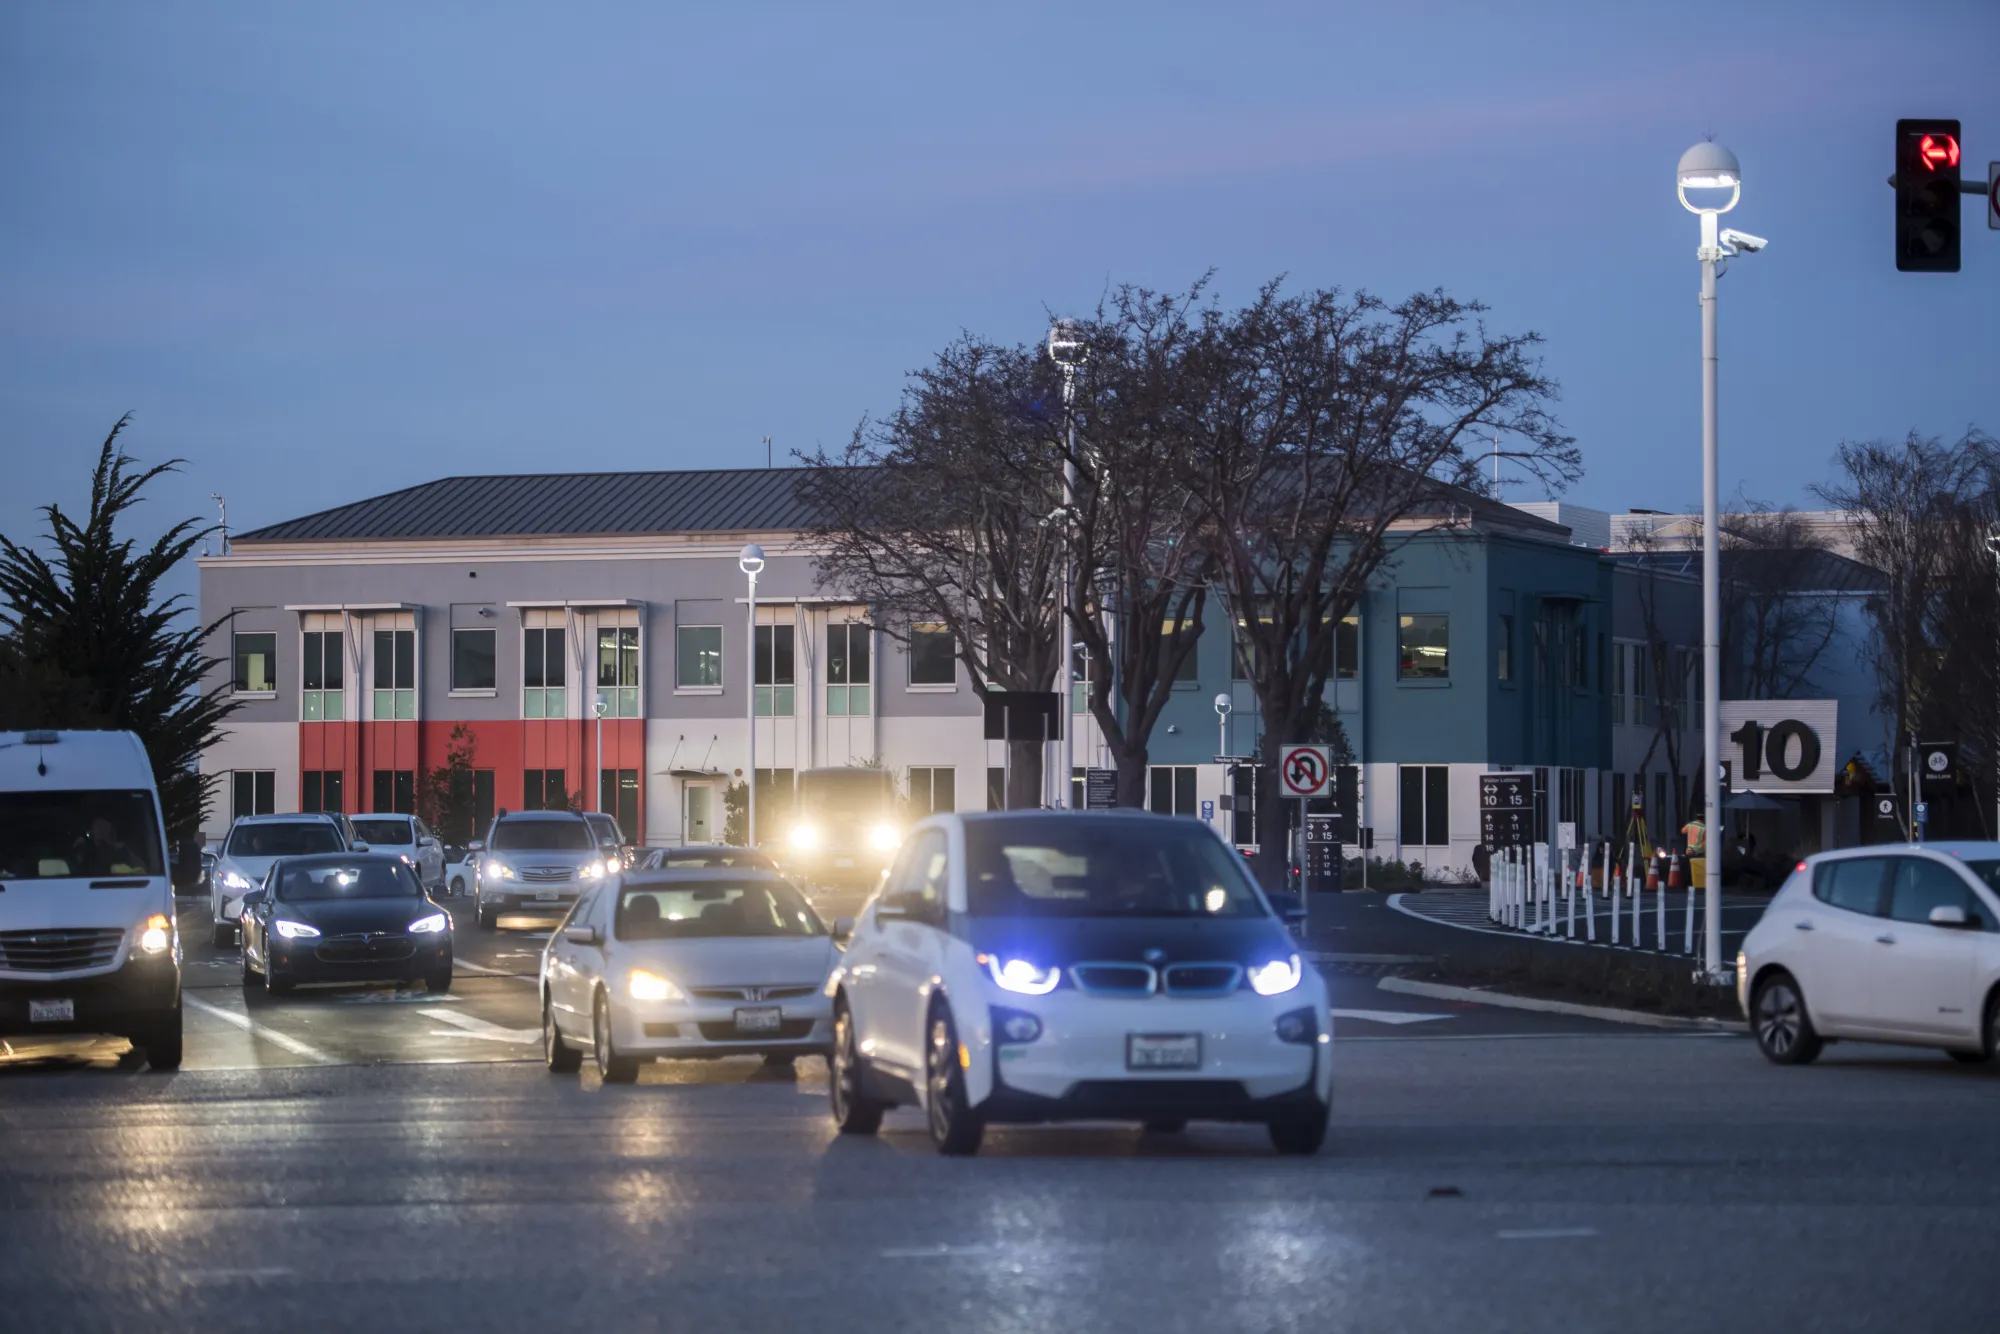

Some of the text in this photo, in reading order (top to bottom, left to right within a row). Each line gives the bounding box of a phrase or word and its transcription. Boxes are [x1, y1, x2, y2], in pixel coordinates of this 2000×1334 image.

[1730, 719, 1821, 781] 10
[1484, 794, 1523, 806] 10 15
[1485, 823, 1519, 831] 12 11
[1307, 831, 1333, 840] 0 15
[1485, 833, 1521, 841] 14 17
